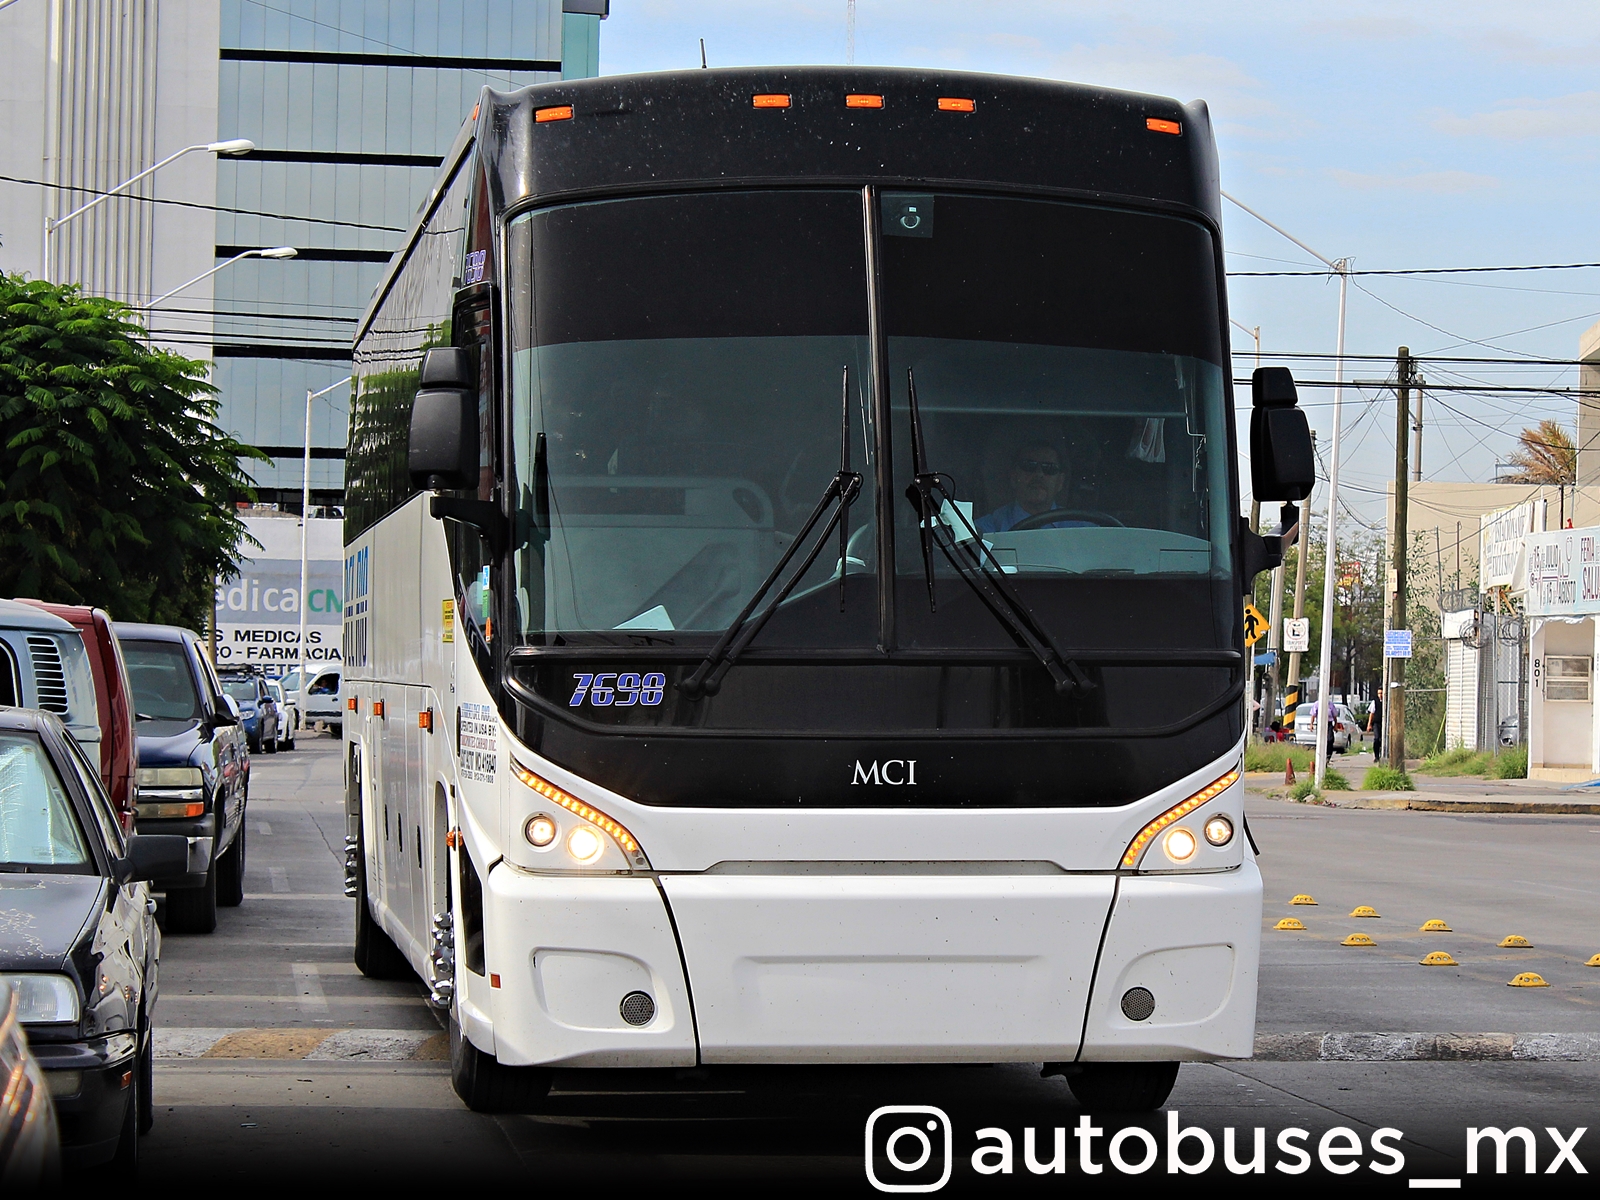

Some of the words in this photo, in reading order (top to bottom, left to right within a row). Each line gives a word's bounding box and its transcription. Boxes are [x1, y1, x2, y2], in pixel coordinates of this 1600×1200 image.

[1582, 566, 1600, 600] SALU
[234, 629, 322, 643] MEDICAS
[569, 673, 666, 706] 7698
[851, 760, 917, 785] MCI
